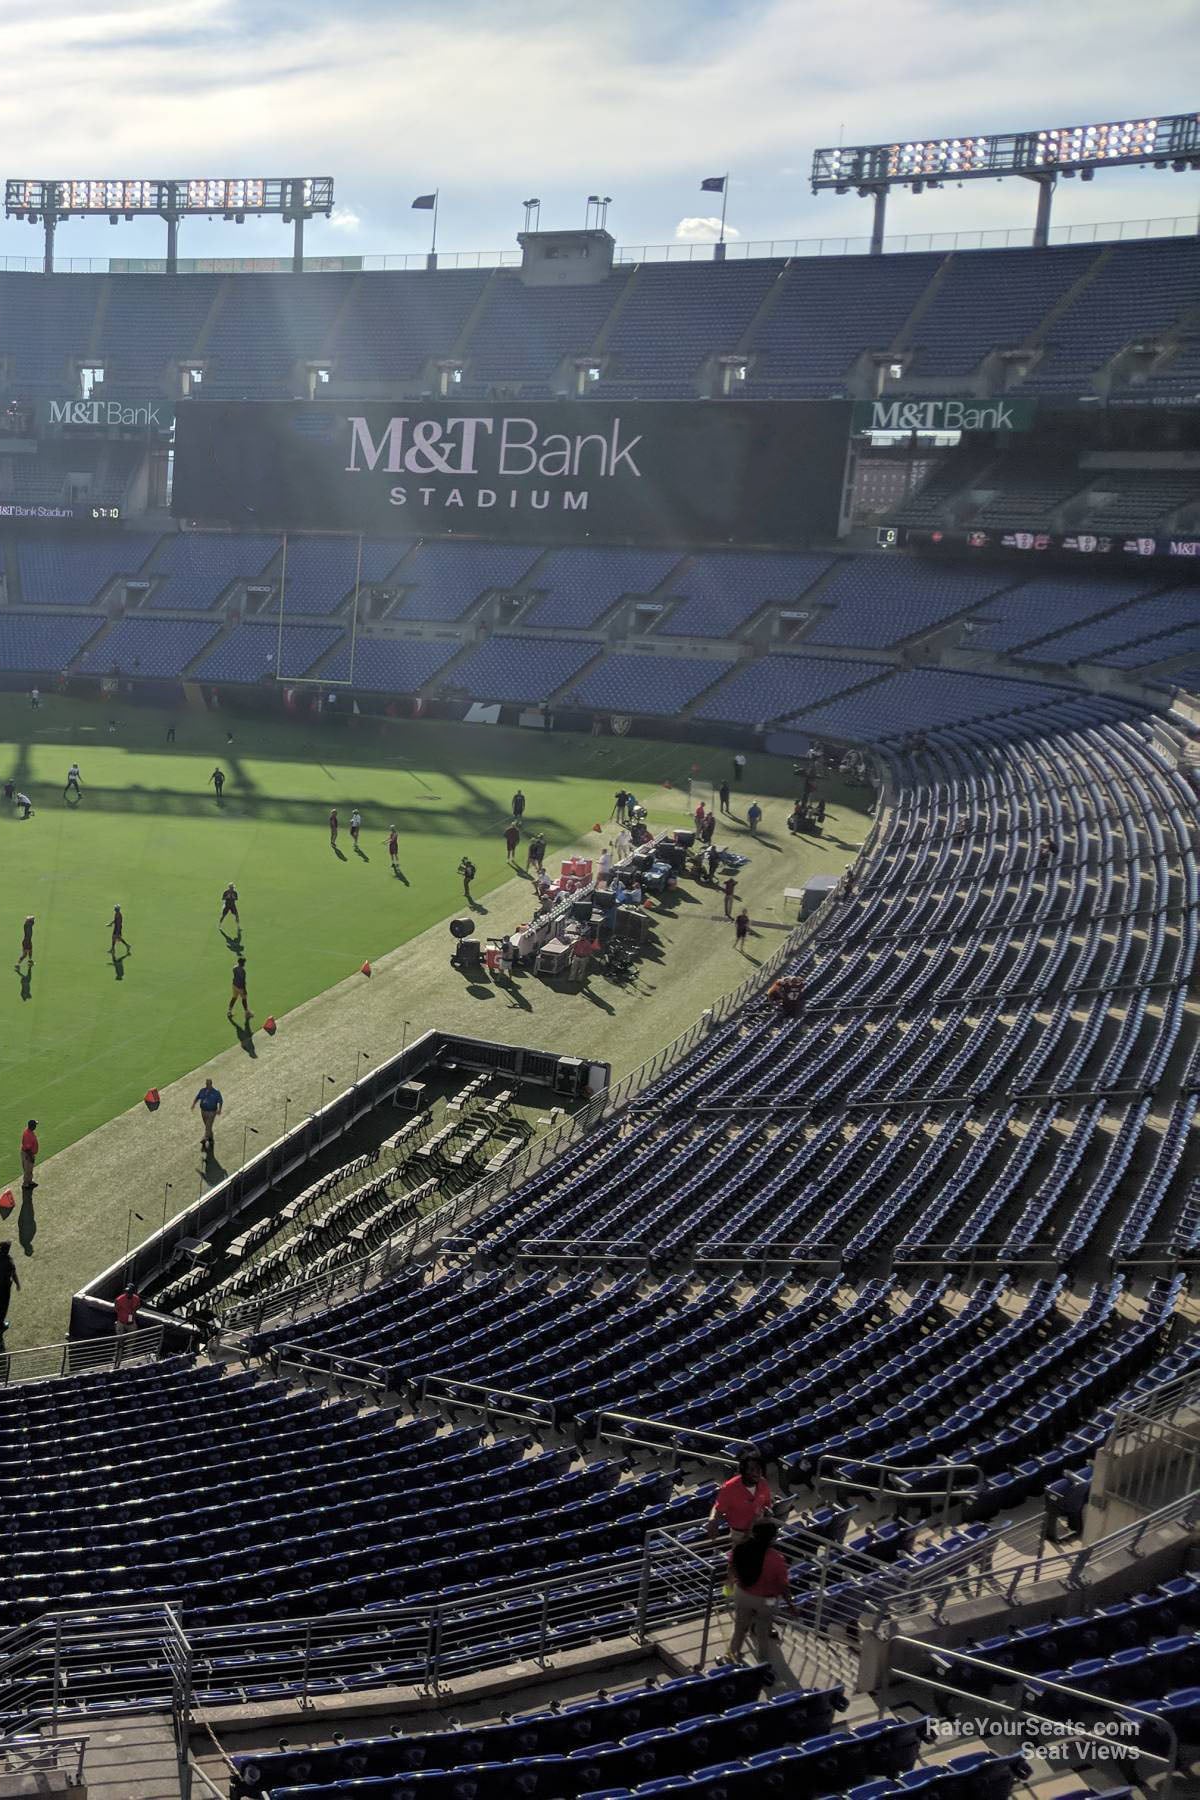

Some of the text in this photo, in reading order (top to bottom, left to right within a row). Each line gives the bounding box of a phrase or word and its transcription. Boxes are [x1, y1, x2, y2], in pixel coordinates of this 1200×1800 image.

[48, 400, 161, 425] M&T Bank
[871, 401, 1014, 430] M&T Bank
[345, 416, 643, 477] M&T Bank
[15, 505, 38, 516] Bank
[389, 487, 589, 510] STADIUM
